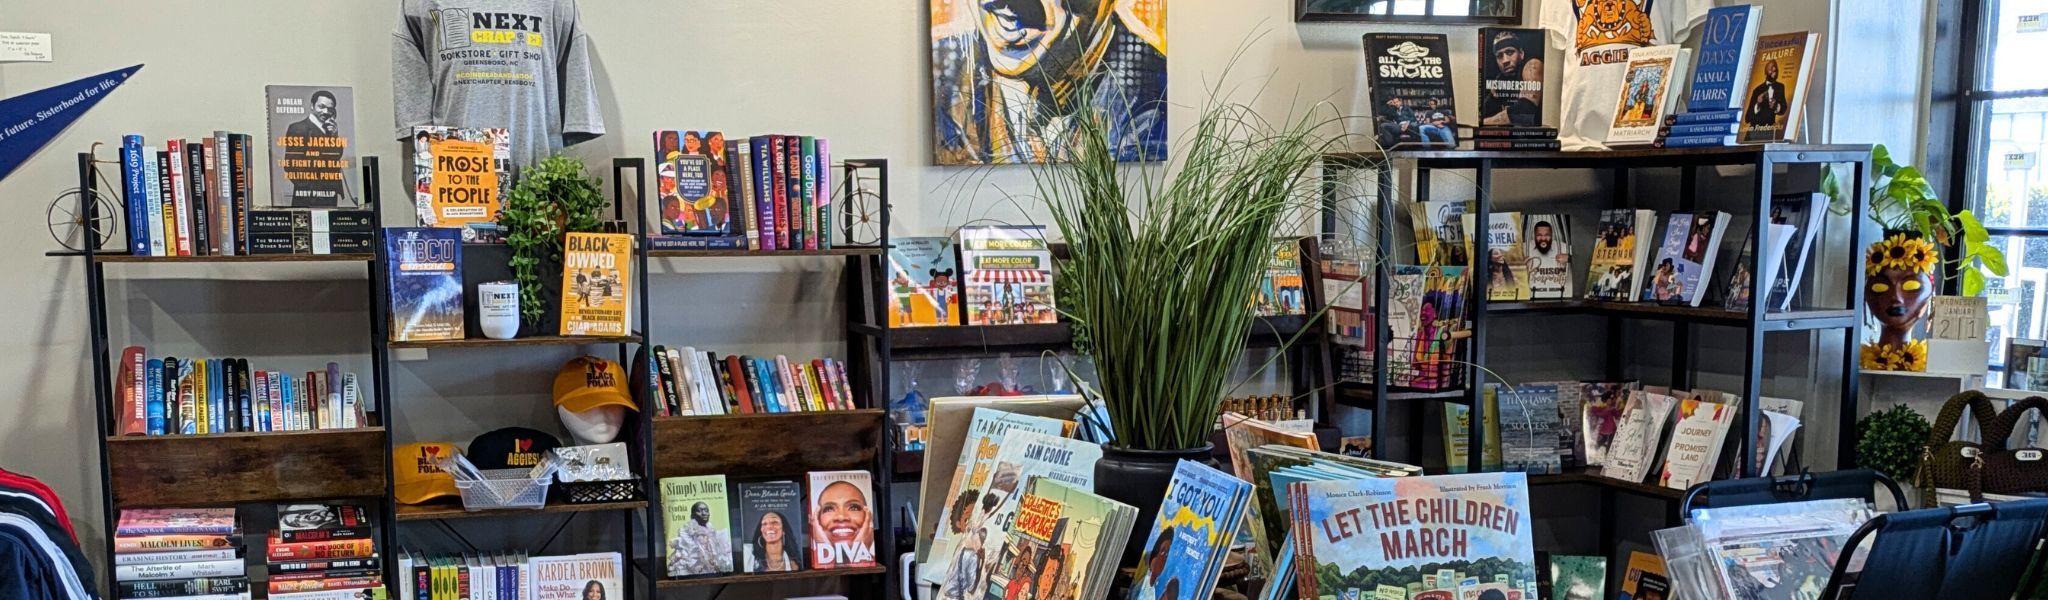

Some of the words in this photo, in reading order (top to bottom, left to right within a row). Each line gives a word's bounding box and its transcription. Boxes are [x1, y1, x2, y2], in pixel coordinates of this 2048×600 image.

[473, 13, 542, 32] NEXT
[1705, 13, 1744, 46] 107
[1379, 56, 1396, 65] ALL
[1423, 56, 1441, 65] THE
[1701, 50, 1736, 65] DAYS
[1762, 49, 1795, 61] FAILURE
[1380, 66, 1443, 79] SMOKE
[1696, 72, 1730, 83] KAMALA
[1486, 80, 1541, 91] MISUNDERSTOOD
[1692, 88, 1728, 101] HARRIS
[5, 118, 37, 137] future.
[36, 92, 85, 122] Sisterhood
[84, 87, 99, 98] for
[100, 78, 118, 91] life.
[277, 136, 304, 147] JESSE
[307, 136, 347, 147] JACKSON
[130, 150, 139, 167] 1619
[438, 156, 488, 172] PROSE
[776, 152, 785, 173] COSBY
[790, 155, 800, 179] COSBY
[805, 155, 813, 181] Good
[284, 172, 318, 180] POLITICAL
[320, 172, 343, 180] POWER
[448, 175, 462, 184] TO
[466, 175, 479, 185] THE
[761, 160, 770, 203] WILLIAMS
[439, 187, 490, 204] PEOPLE
[805, 182, 813, 198] Dirt
[1489, 222, 1512, 230] ueen,
[569, 236, 614, 252] BLACK-
[1496, 233, 1516, 244] HEAL
[398, 239, 454, 262] HBCU
[568, 252, 615, 269] OWNED
[1681, 427, 1712, 436] JOURNEY
[515, 439, 520, 453] I
[1674, 443, 1708, 452] PROMISED
[507, 452, 541, 466] AGGIES!
[1025, 443, 1044, 460] SAM
[1043, 448, 1073, 466] COOKE
[1070, 475, 1088, 486] SMITH
[667, 482, 697, 497] Simply
[700, 481, 723, 493] More
[1440, 484, 1467, 493] Illustrated
[1167, 479, 1179, 500] I
[1177, 483, 1202, 510] GOT
[1198, 489, 1226, 522] YOU
[668, 504, 688, 513] Cynthia
[1322, 507, 1362, 544] LET
[1366, 499, 1411, 530] THE
[1414, 498, 1520, 536] CHILDREN
[141, 540, 177, 549] MALCOLM
[1380, 527, 1468, 561] MARCH
[818, 542, 872, 564] DIVA
[538, 564, 576, 581] KARDEA
[580, 562, 615, 580] BROWN
[538, 586, 558, 594] Make
